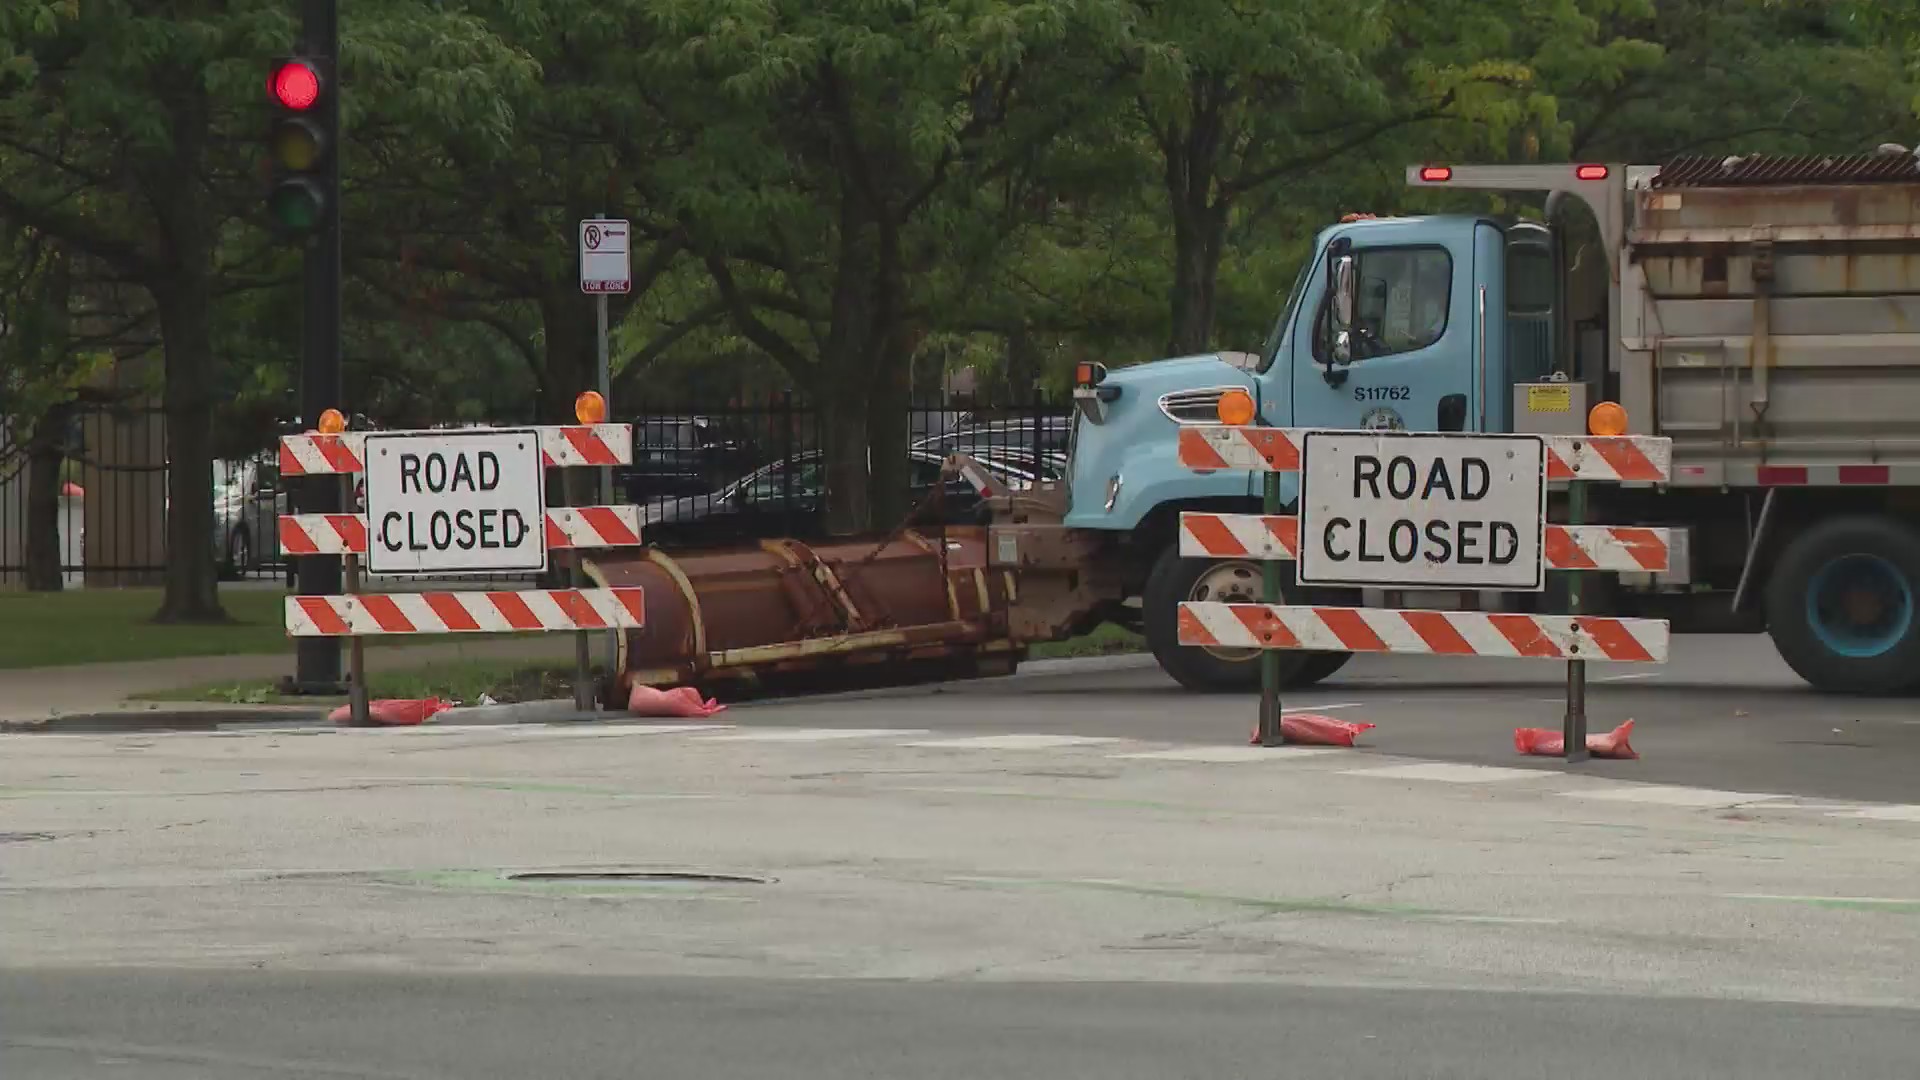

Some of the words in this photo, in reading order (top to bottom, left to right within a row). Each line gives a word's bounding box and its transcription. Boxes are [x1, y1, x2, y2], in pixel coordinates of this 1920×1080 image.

[1354, 386, 1410, 401] S11762
[400, 451, 500, 494] ROAD
[1353, 455, 1490, 501] ROAD
[382, 509, 525, 552] CLOSED
[1323, 517, 1519, 565] CLOSED
